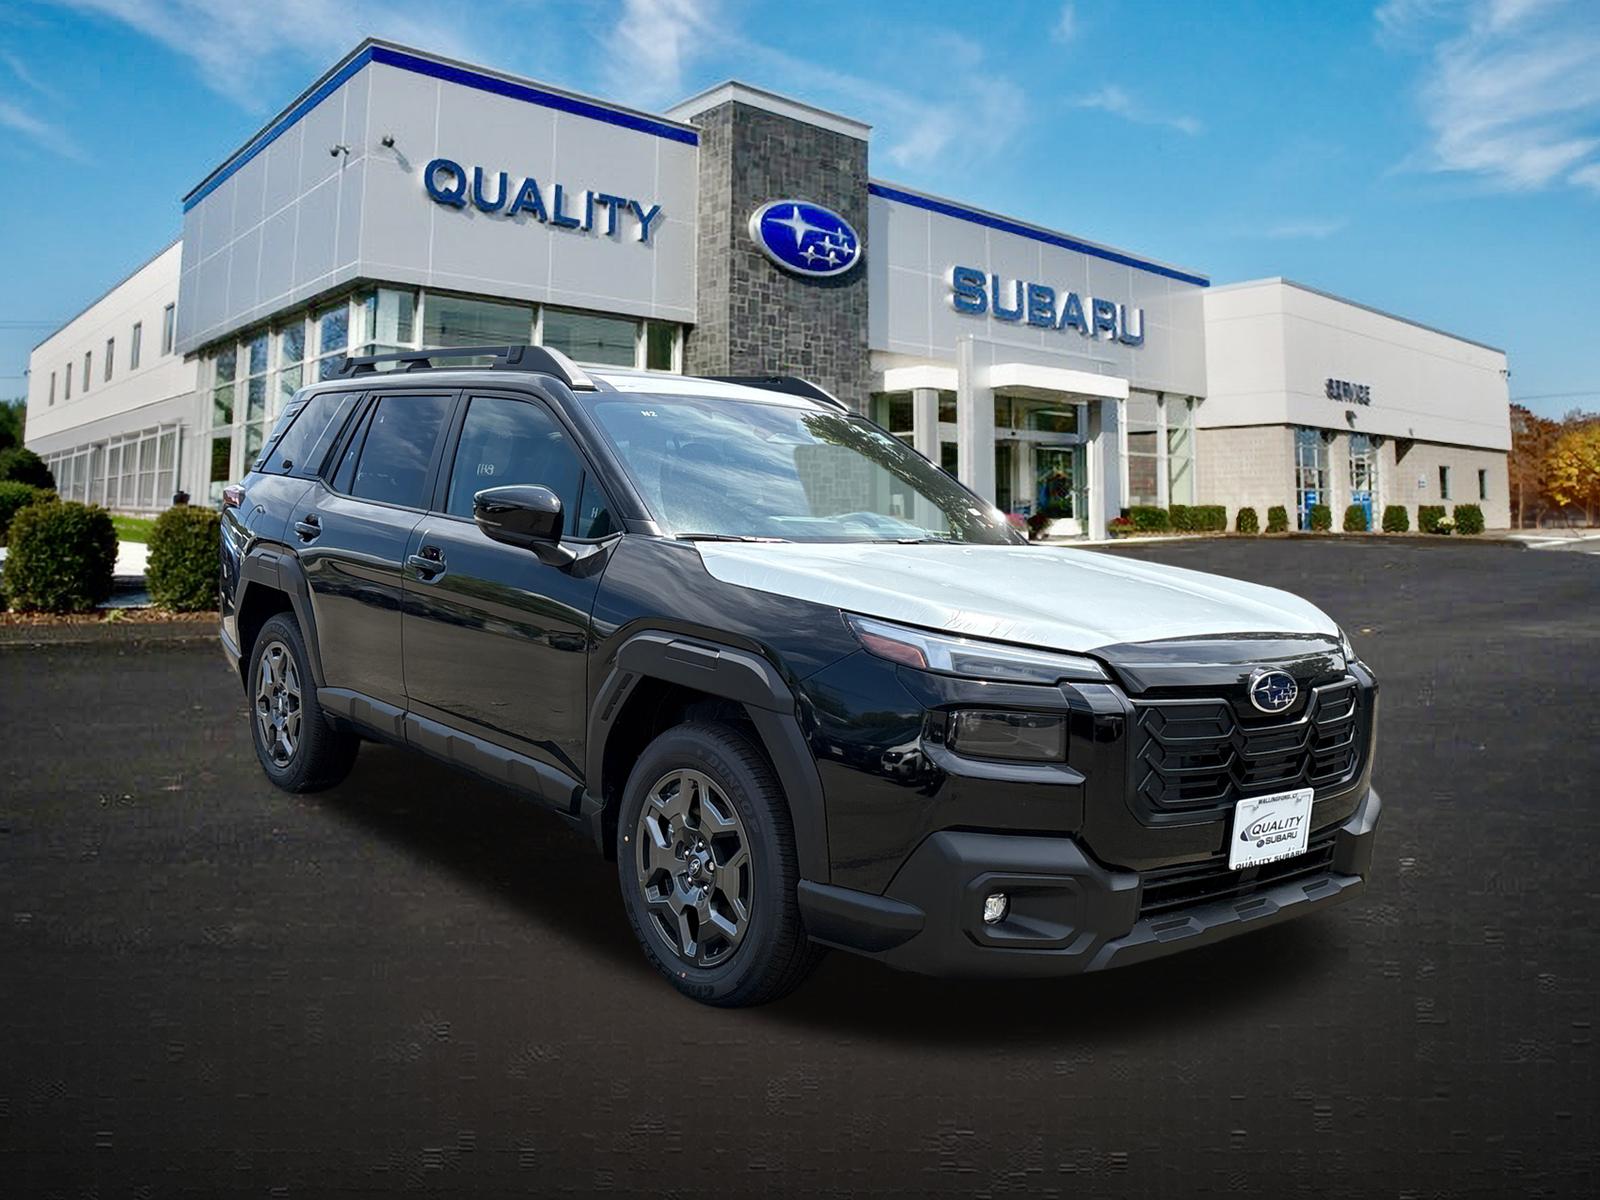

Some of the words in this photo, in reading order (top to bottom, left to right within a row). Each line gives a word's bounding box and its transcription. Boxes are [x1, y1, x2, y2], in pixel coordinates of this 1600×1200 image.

[424, 158, 661, 243] QUALITY
[948, 265, 1145, 347] SUBARU
[1325, 378, 1371, 406] SERVICE
[1252, 815, 1304, 835] QUALITY
[1265, 831, 1298, 845] SUBARU
[1236, 857, 1271, 869] QUALITY
[1274, 849, 1306, 861] SUBARU
